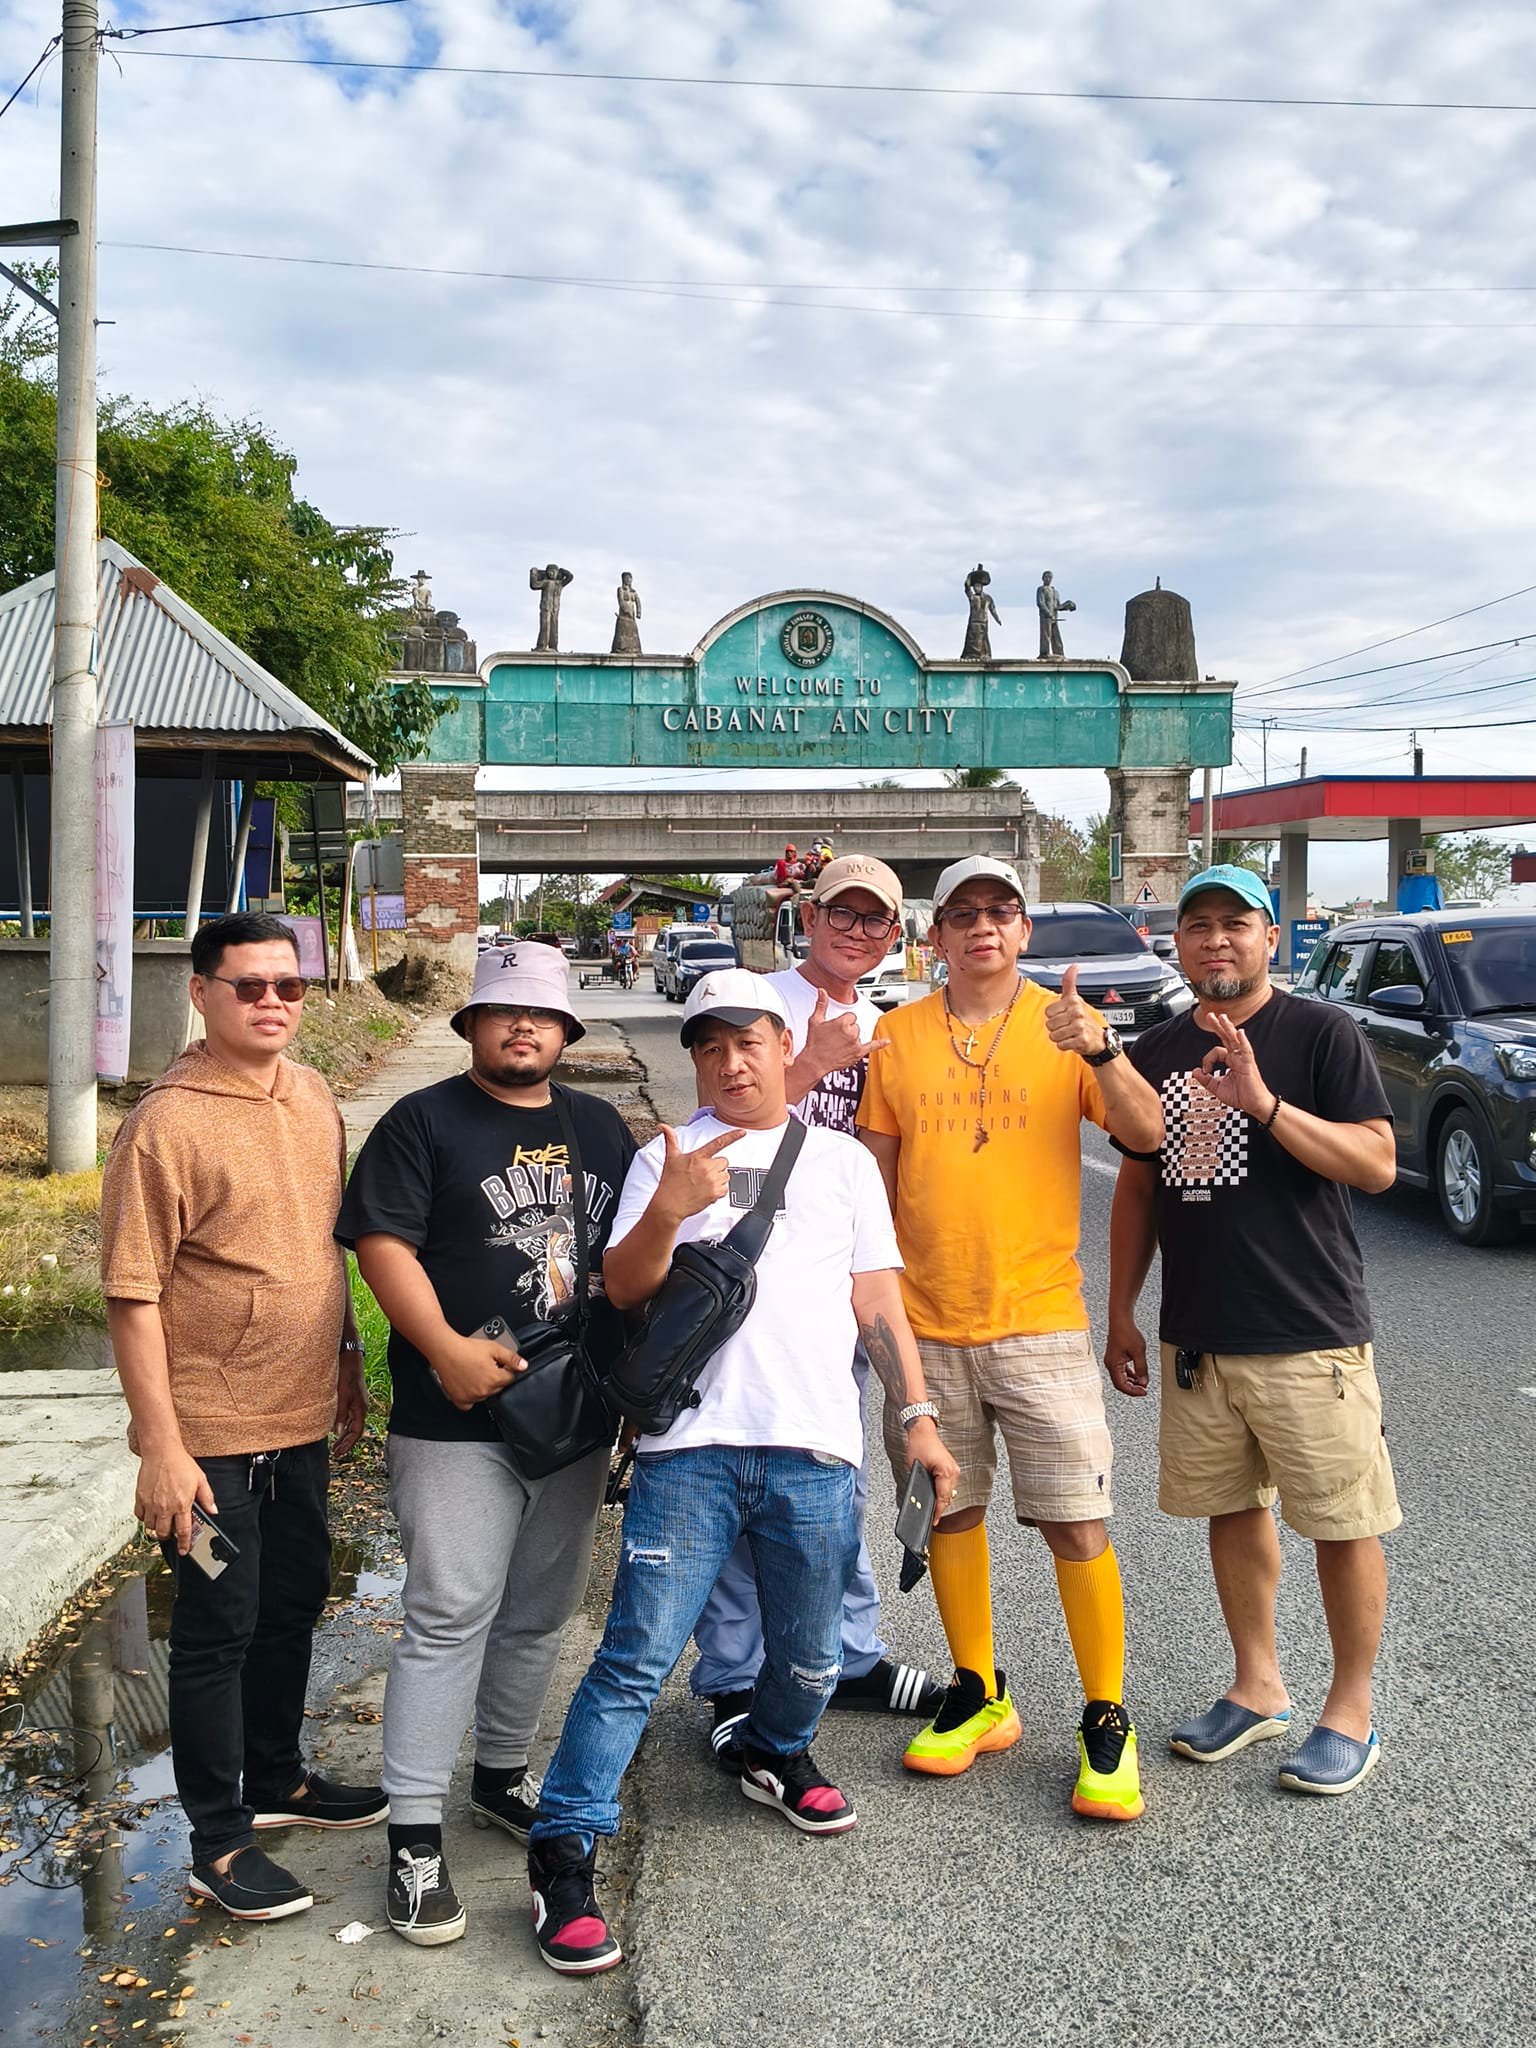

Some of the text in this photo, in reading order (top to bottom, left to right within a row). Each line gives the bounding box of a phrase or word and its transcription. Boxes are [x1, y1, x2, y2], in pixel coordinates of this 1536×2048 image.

[735, 676, 882, 697] WELCOME TO
[883, 708, 957, 735] CITY
[846, 863, 877, 876] NYC
[1296, 923, 1324, 931] DIESEL
[501, 952, 518, 969] R
[948, 1064, 1001, 1080] NINE
[920, 1088, 1027, 1107] RUNNING
[920, 1115, 1027, 1134] DIVISION
